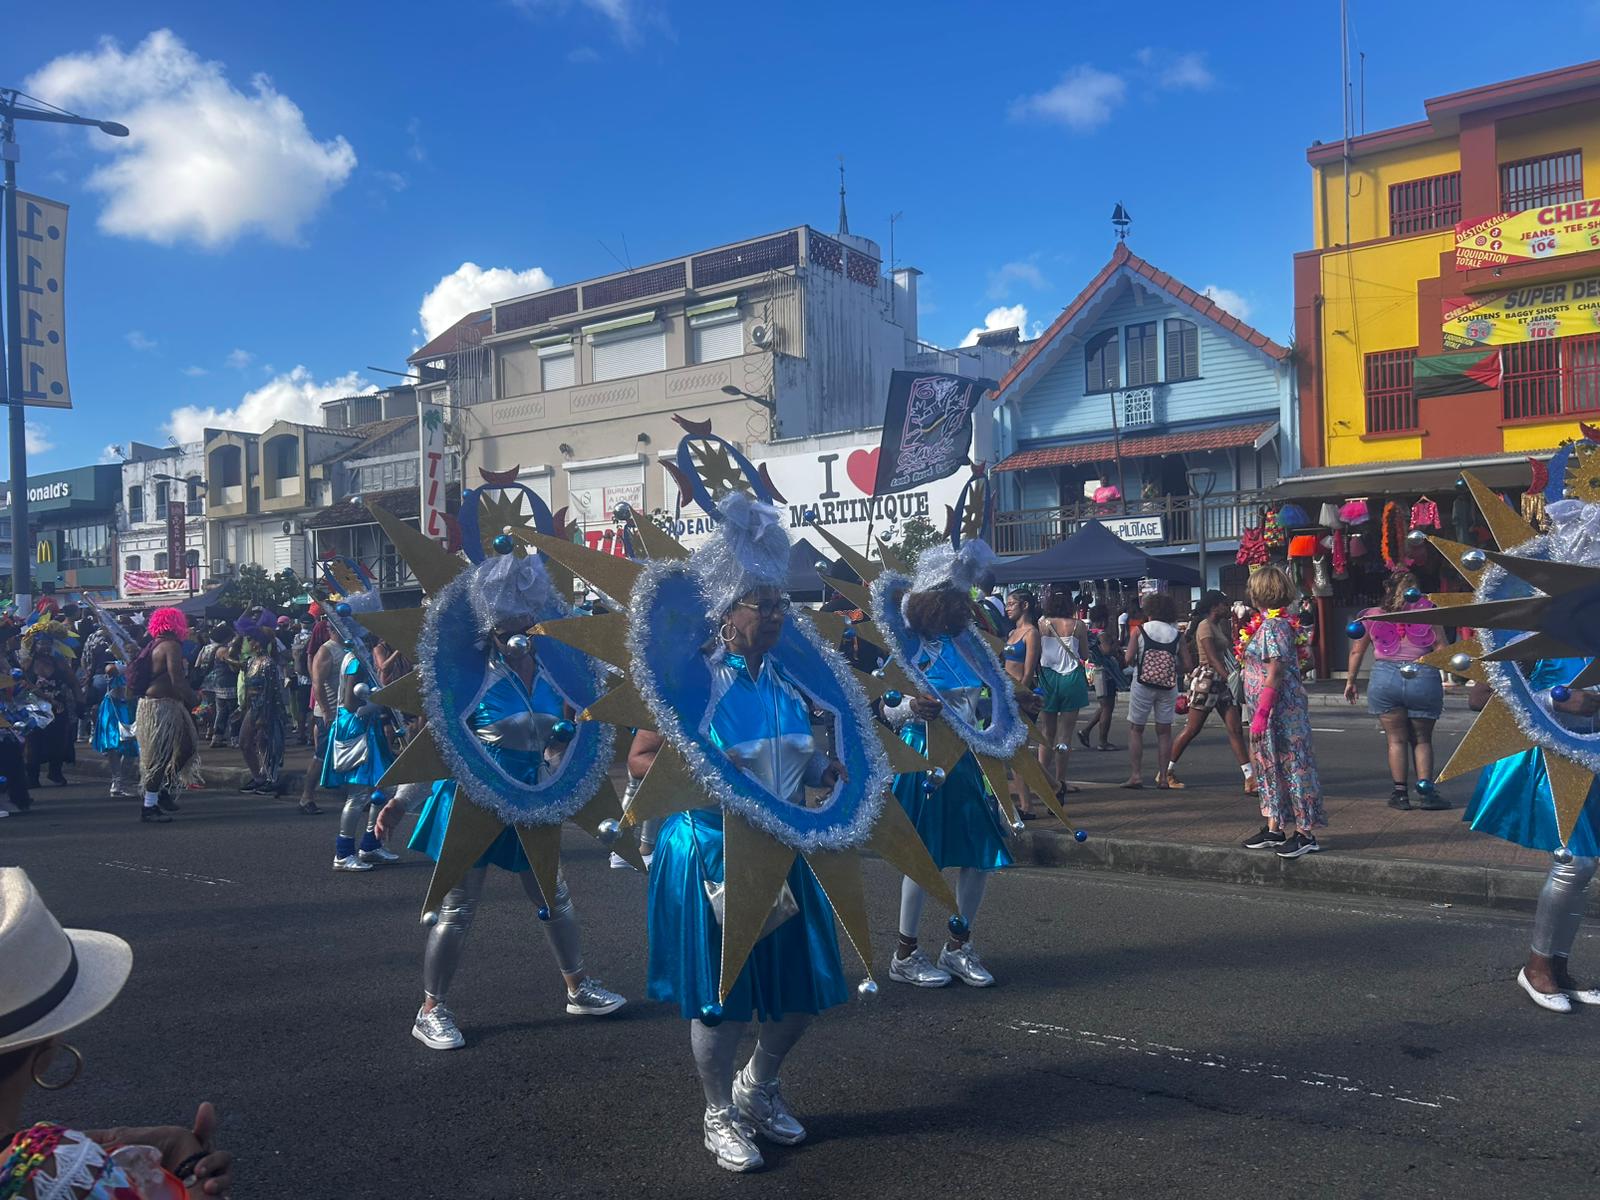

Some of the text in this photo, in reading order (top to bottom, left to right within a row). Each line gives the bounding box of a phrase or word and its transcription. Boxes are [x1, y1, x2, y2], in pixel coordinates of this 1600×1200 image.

[1537, 199, 1600, 225] CHEZ
[1520, 228, 1555, 240] JEANS
[1455, 257, 1482, 268] TOTALE
[1456, 248, 1509, 264] LIQUIDATION
[1504, 284, 1567, 309] SUPER
[1457, 311, 1500, 323] SOUTIENS
[1505, 310, 1534, 319] BAGGY
[1536, 305, 1570, 315] SHORTS
[1529, 314, 1557, 323] JEANS
[818, 453, 841, 500] I
[789, 491, 929, 527] MARTINIQUE
